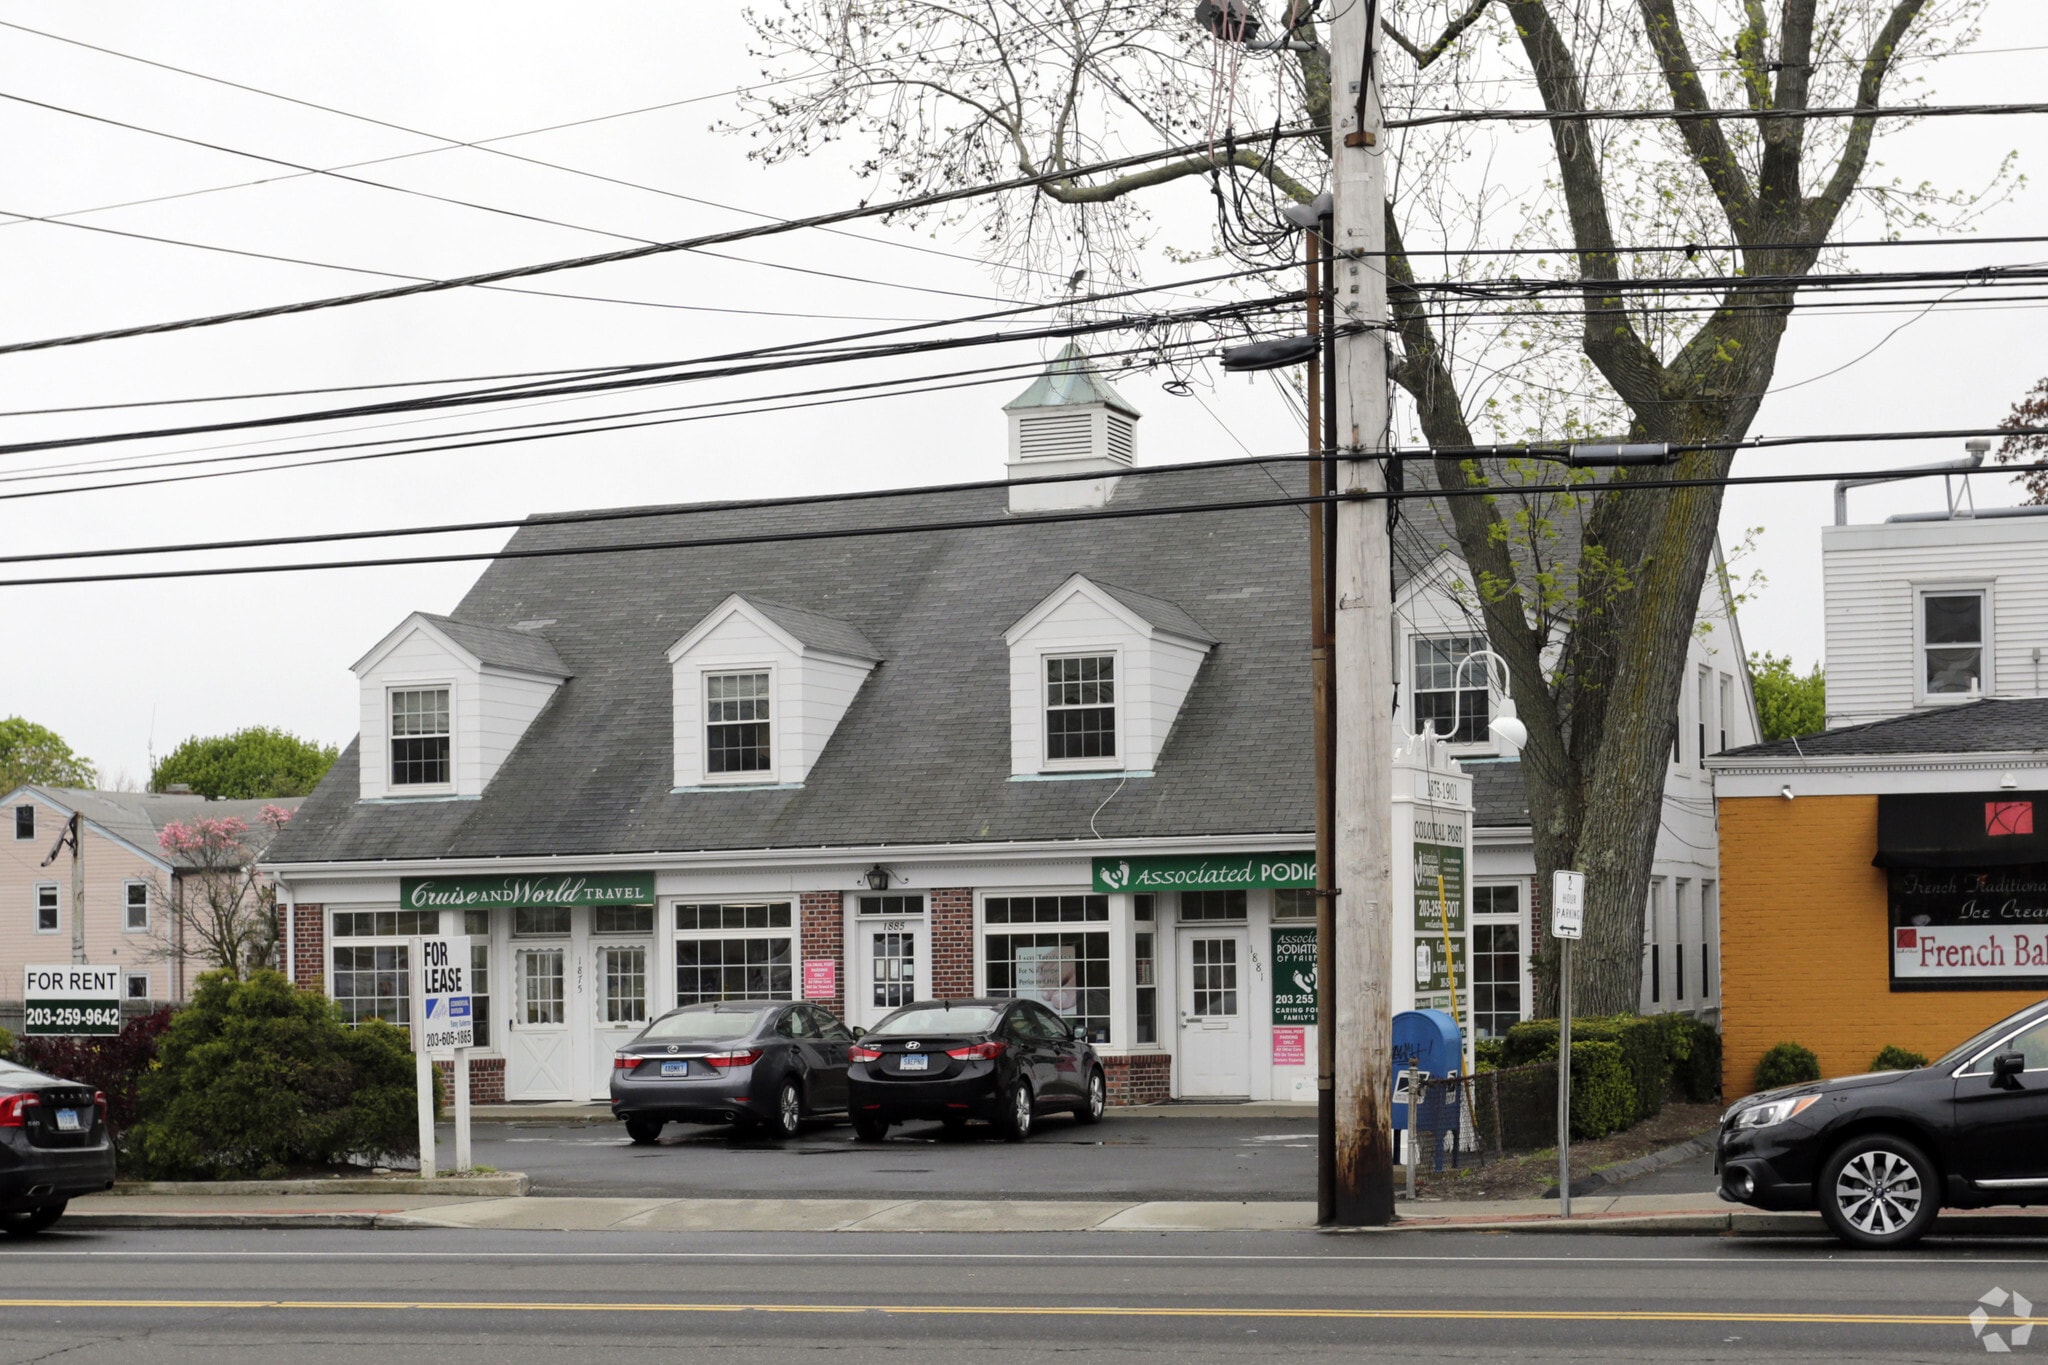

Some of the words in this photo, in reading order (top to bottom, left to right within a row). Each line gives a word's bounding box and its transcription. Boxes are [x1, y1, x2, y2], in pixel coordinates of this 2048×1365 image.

[1414, 820, 1445, 841] COLONIAL
[1447, 825, 1462, 843] POST
[1135, 860, 1256, 885] Associated
[411, 881, 481, 907] Cruise
[480, 890, 513, 902] AND
[504, 877, 586, 904] World
[584, 887, 644, 899] TRAVEL
[1568, 880, 1573, 890] 2
[1904, 874, 1957, 894] French
[1562, 893, 1577, 904] HOUR
[1958, 899, 1991, 919] Ice
[2000, 898, 2048, 918] Crea
[1556, 908, 1580, 920] PARKING
[883, 921, 905, 931] 1885
[424, 941, 448, 967] FOR
[1919, 934, 2005, 967] French
[2013, 934, 2048, 966] Ba
[1250, 945, 1263, 981] 1881
[28, 972, 63, 990] FOR
[70, 972, 117, 990] RENT
[424, 967, 462, 994] LEASE
[1275, 994, 1293, 1004] 203
[1295, 994, 1314, 1004] 255
[26, 1008, 119, 1026] 203-259-9642
[426, 1030, 472, 1047] 203-605-1865
